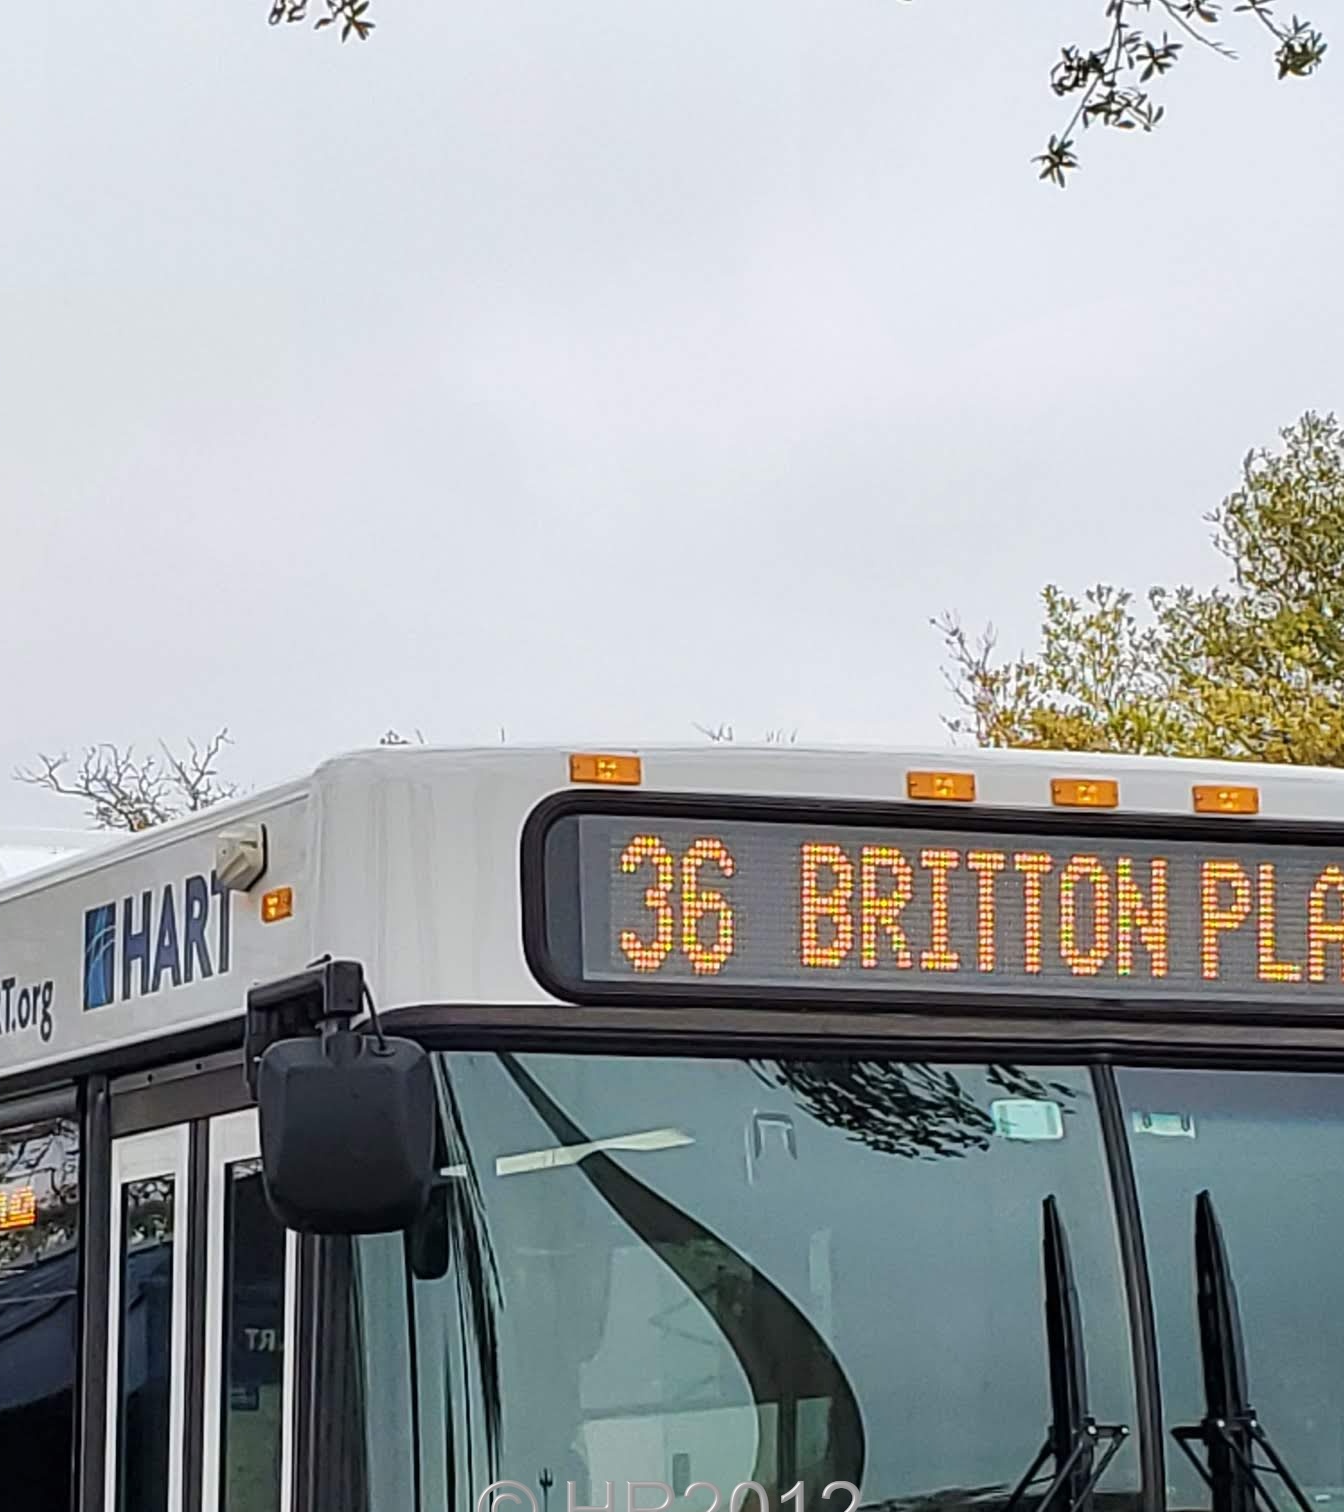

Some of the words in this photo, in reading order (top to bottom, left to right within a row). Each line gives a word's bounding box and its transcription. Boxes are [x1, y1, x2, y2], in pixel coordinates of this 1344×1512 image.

[121, 869, 232, 1001] HART
[618, 834, 735, 975] 36
[799, 842, 1168, 979] BRITTON
